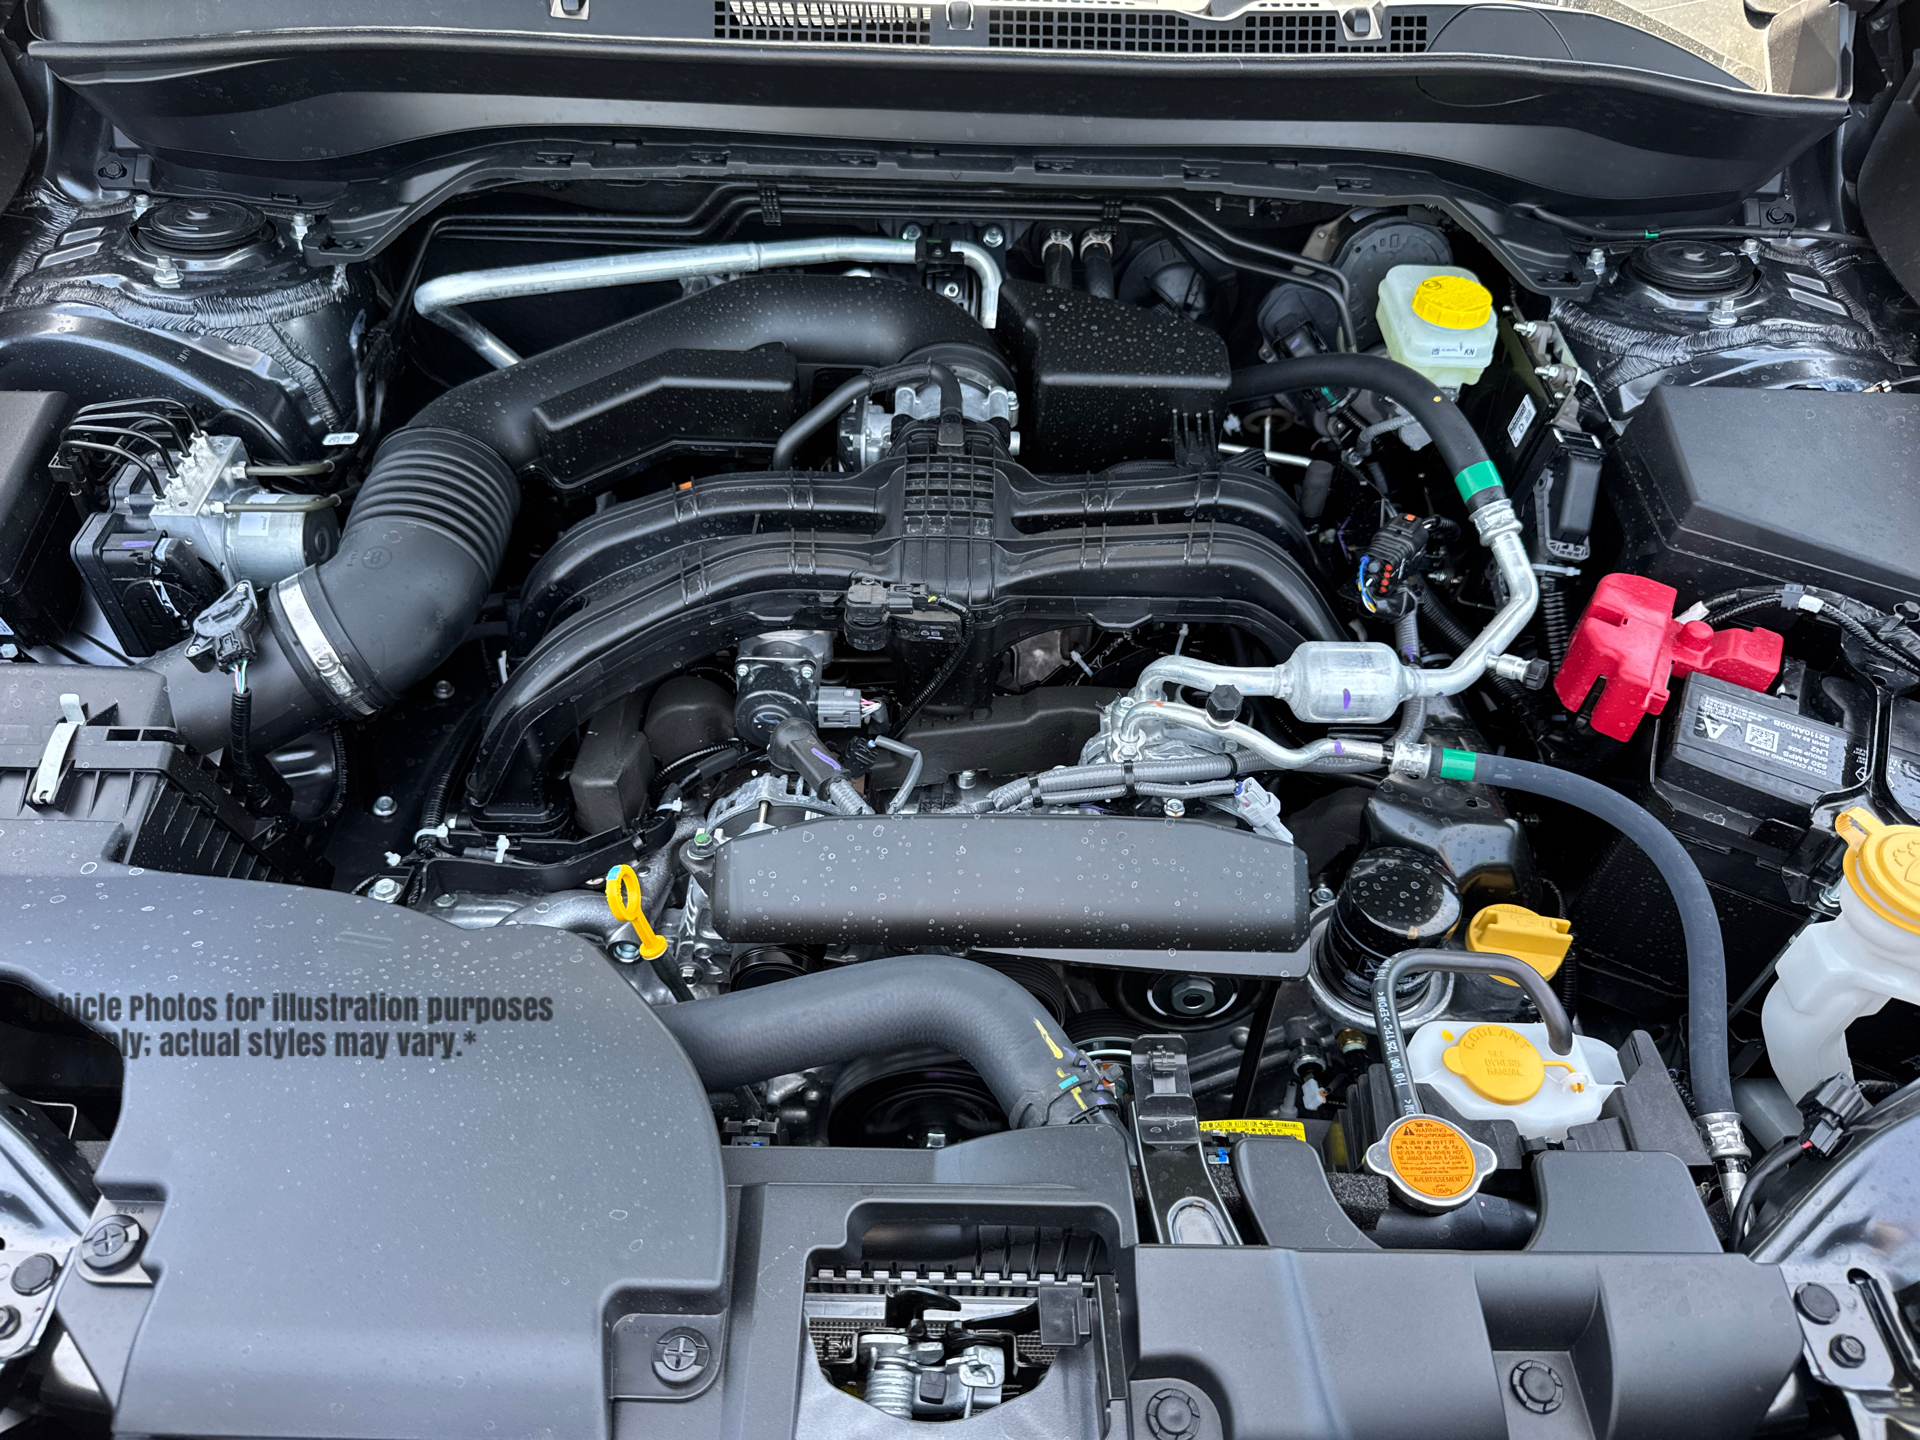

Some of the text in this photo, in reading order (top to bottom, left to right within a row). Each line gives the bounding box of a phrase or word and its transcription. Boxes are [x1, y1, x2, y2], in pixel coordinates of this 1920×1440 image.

[1782, 750, 1810, 764] AMPS
[1787, 745, 1828, 763] GROUP SIZE
[1811, 745, 1829, 757] LN2
[1750, 746, 1827, 776] COLD CRANKING AMPS
[1384, 1023, 1396, 1041] TPC
[1463, 1027, 1531, 1050] COOLANT
[1487, 1049, 1505, 1058] SEE
[1486, 1067, 1524, 1077] MANUAL
[115, 1206, 145, 1214] ELSA
